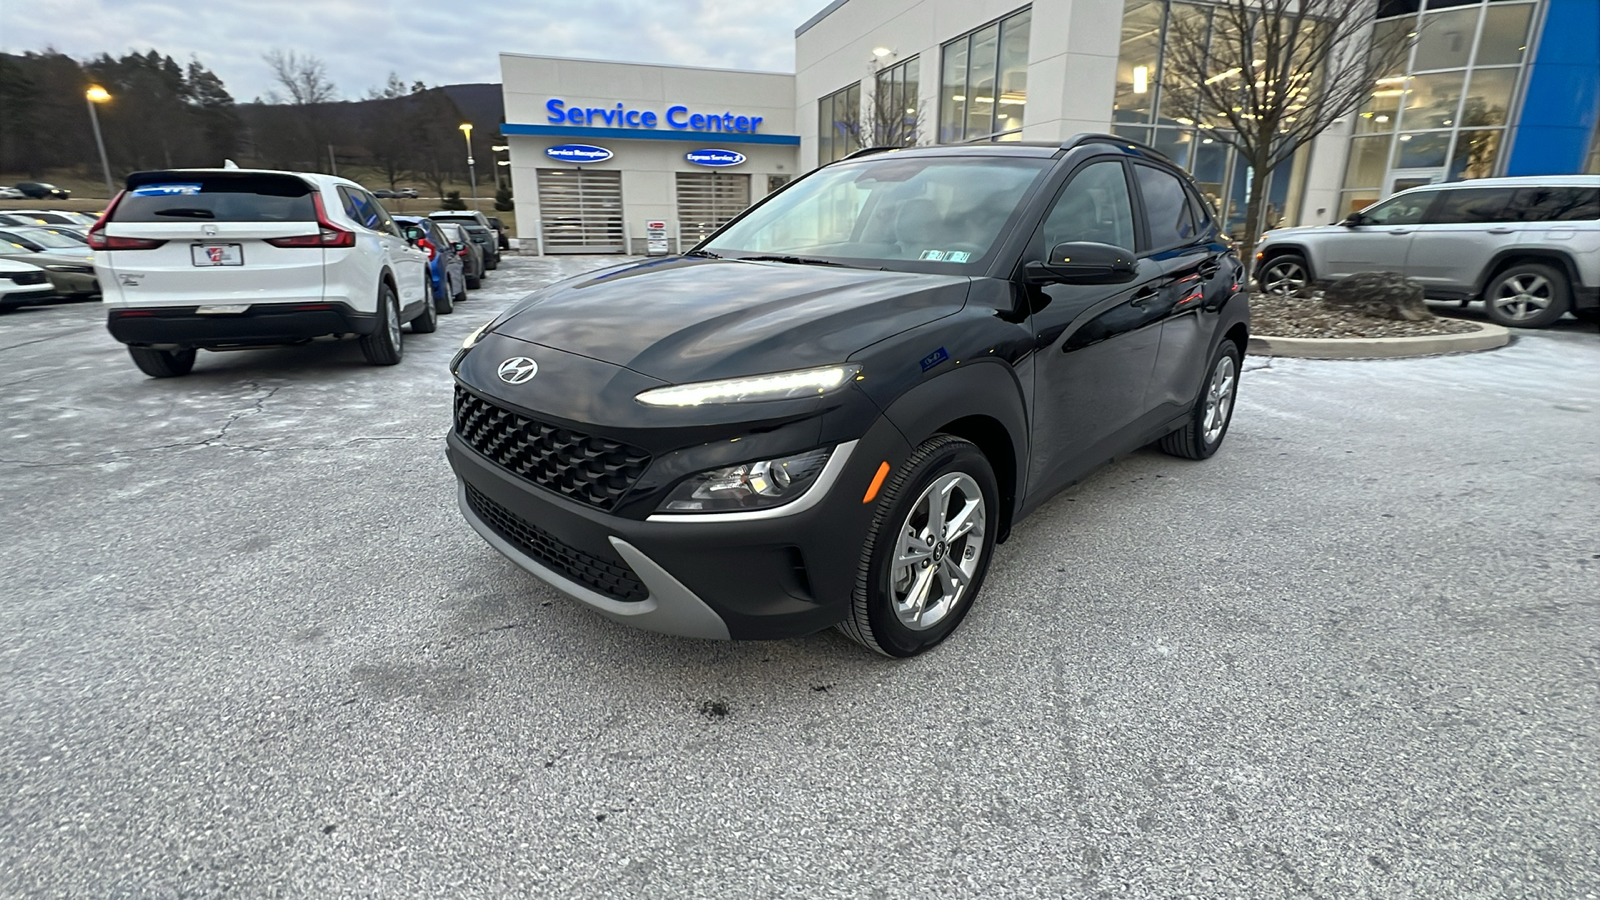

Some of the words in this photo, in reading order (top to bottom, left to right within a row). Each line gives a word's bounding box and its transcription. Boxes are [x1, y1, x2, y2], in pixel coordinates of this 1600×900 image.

[546, 98, 657, 128] Service
[666, 105, 763, 132] Center
[547, 148, 574, 156] Service
[574, 149, 609, 158] Reception
[687, 153, 711, 161] Express
